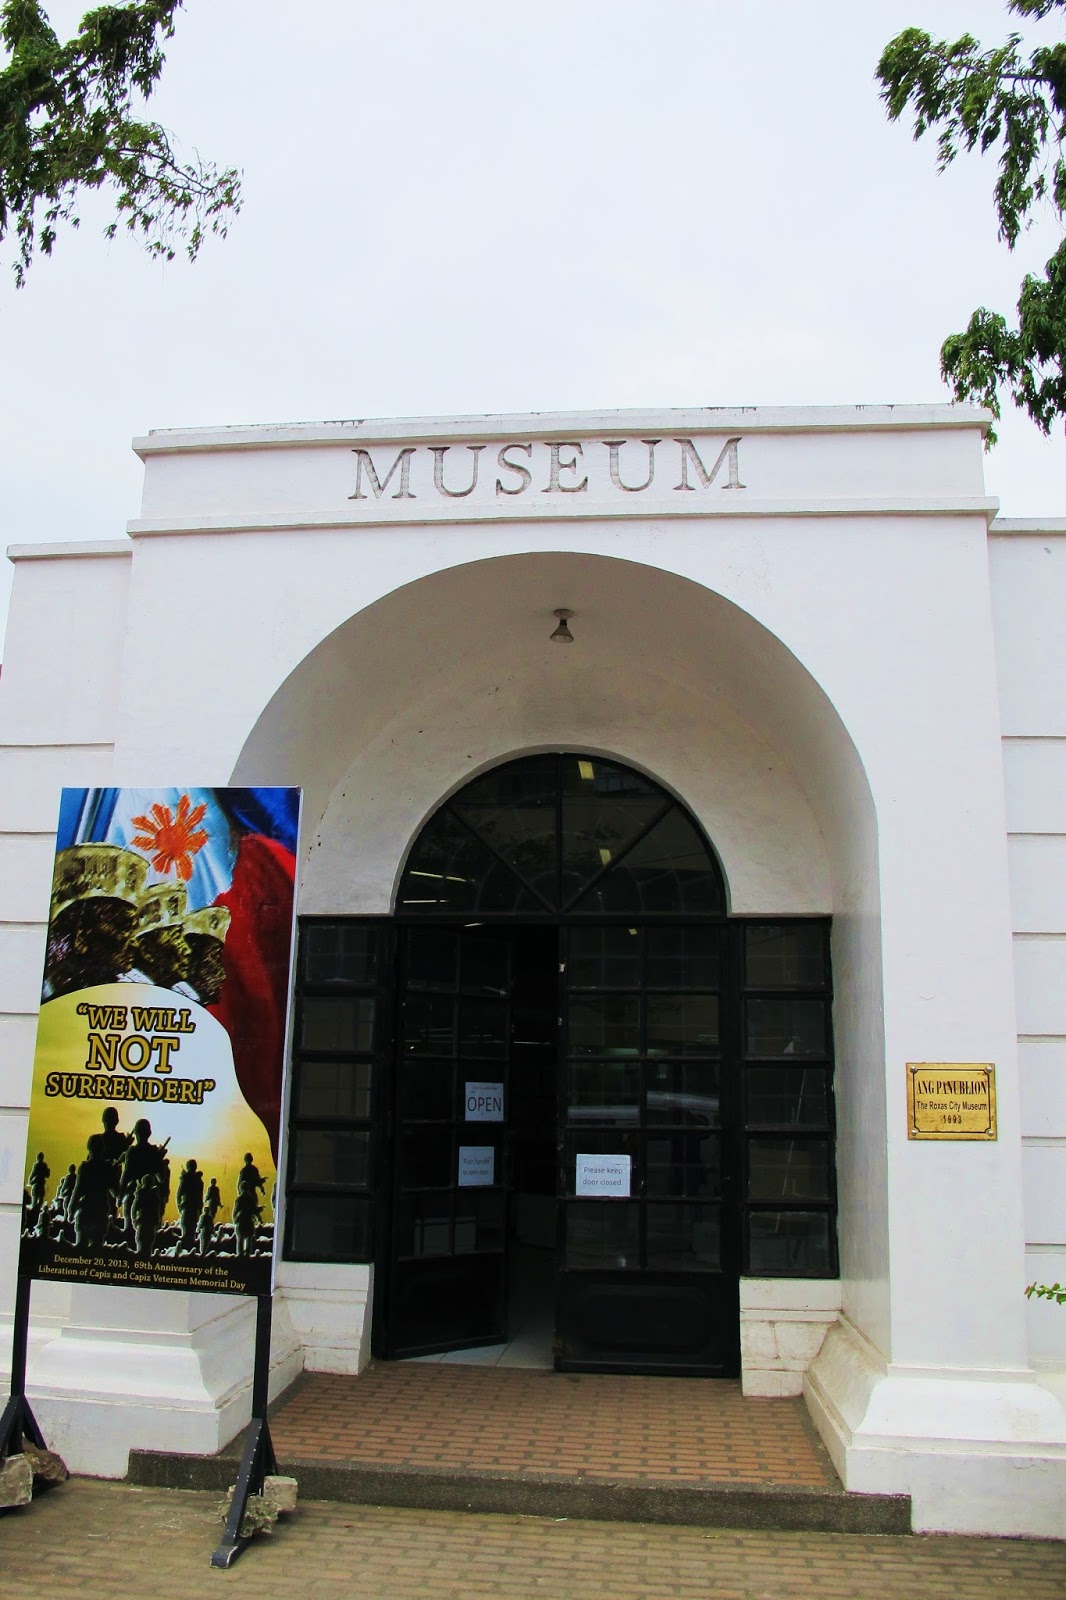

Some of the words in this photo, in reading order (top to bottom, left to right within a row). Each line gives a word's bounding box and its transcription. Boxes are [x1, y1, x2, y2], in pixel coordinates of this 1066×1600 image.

[346, 436, 748, 500] MUSEUM
[130, 1006, 197, 1033] WILL
[85, 1033, 180, 1074] NOT
[45, 1070, 216, 1105] SURRENDER!”
[917, 1080, 935, 1095] ANG
[936, 1080, 987, 1095] PANUBLION
[467, 1096, 502, 1112] OPEN
[916, 1101, 928, 1110] The
[929, 1101, 948, 1110] Roxas
[949, 1101, 961, 1112] City
[962, 1101, 988, 1111] Museum
[942, 1115, 963, 1124] 1993
[583, 1166, 605, 1174] Please
[607, 1167, 623, 1175] keep
[54, 1254, 92, 1265] December
[93, 1257, 106, 1267] 20,
[108, 1259, 130, 1269] 2013,
[134, 1260, 153, 1270] 69th
[154, 1262, 203, 1276] Anniversary
[204, 1266, 214, 1275] of
[215, 1267, 229, 1276] the
[38, 1265, 78, 1276] Liberation
[79, 1268, 89, 1276] of
[89, 1269, 111, 1280] Capiz
[112, 1271, 128, 1280] and
[129, 1272, 152, 1282] Capiz
[153, 1274, 188, 1285] Veterans
[189, 1277, 228, 1288] Memorial
[230, 1280, 246, 1291] Day
